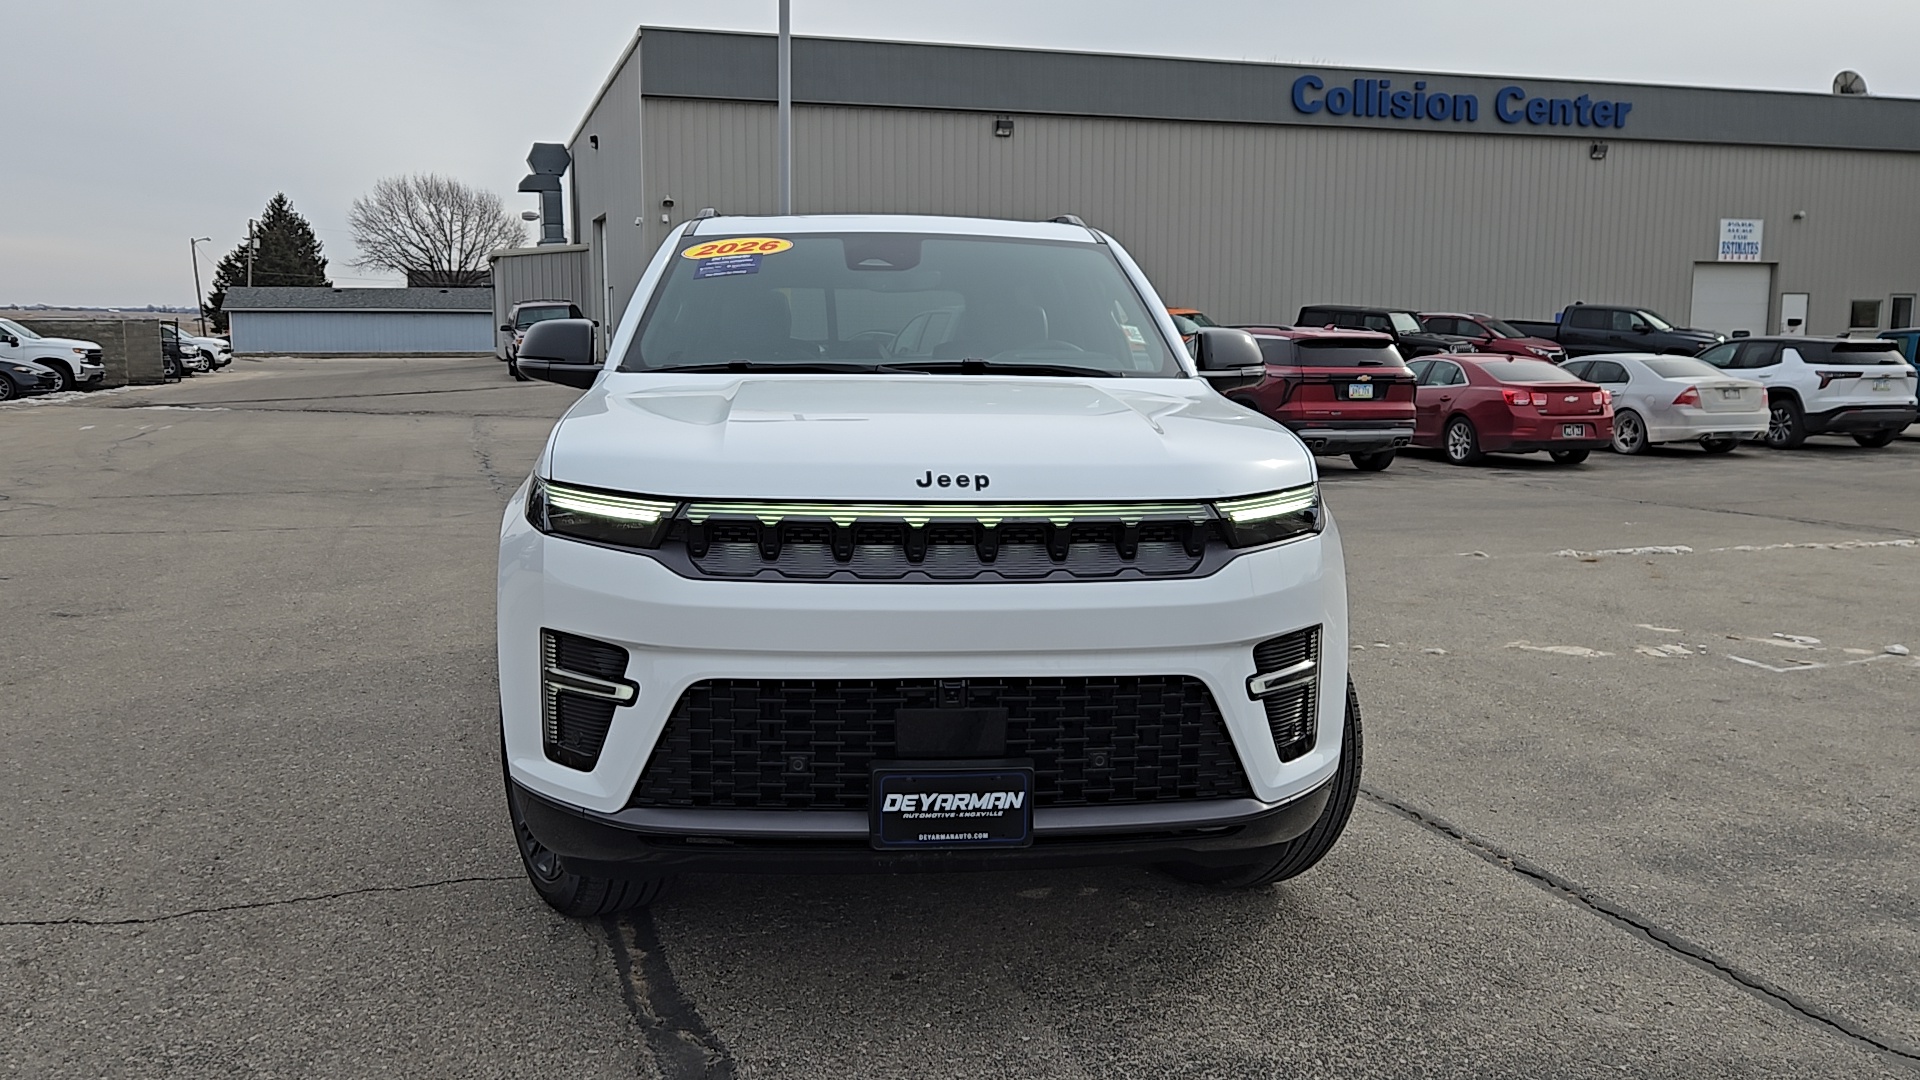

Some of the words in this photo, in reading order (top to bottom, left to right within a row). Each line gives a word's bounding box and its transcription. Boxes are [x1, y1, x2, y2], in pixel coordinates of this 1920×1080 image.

[1291, 74, 1479, 122] Collision
[1495, 85, 1633, 129] Center
[693, 240, 781, 257] 2026
[1721, 241, 1760, 255] ESTIMATES
[916, 470, 990, 492] Jeep
[882, 791, 1025, 812] DEYARMAN
